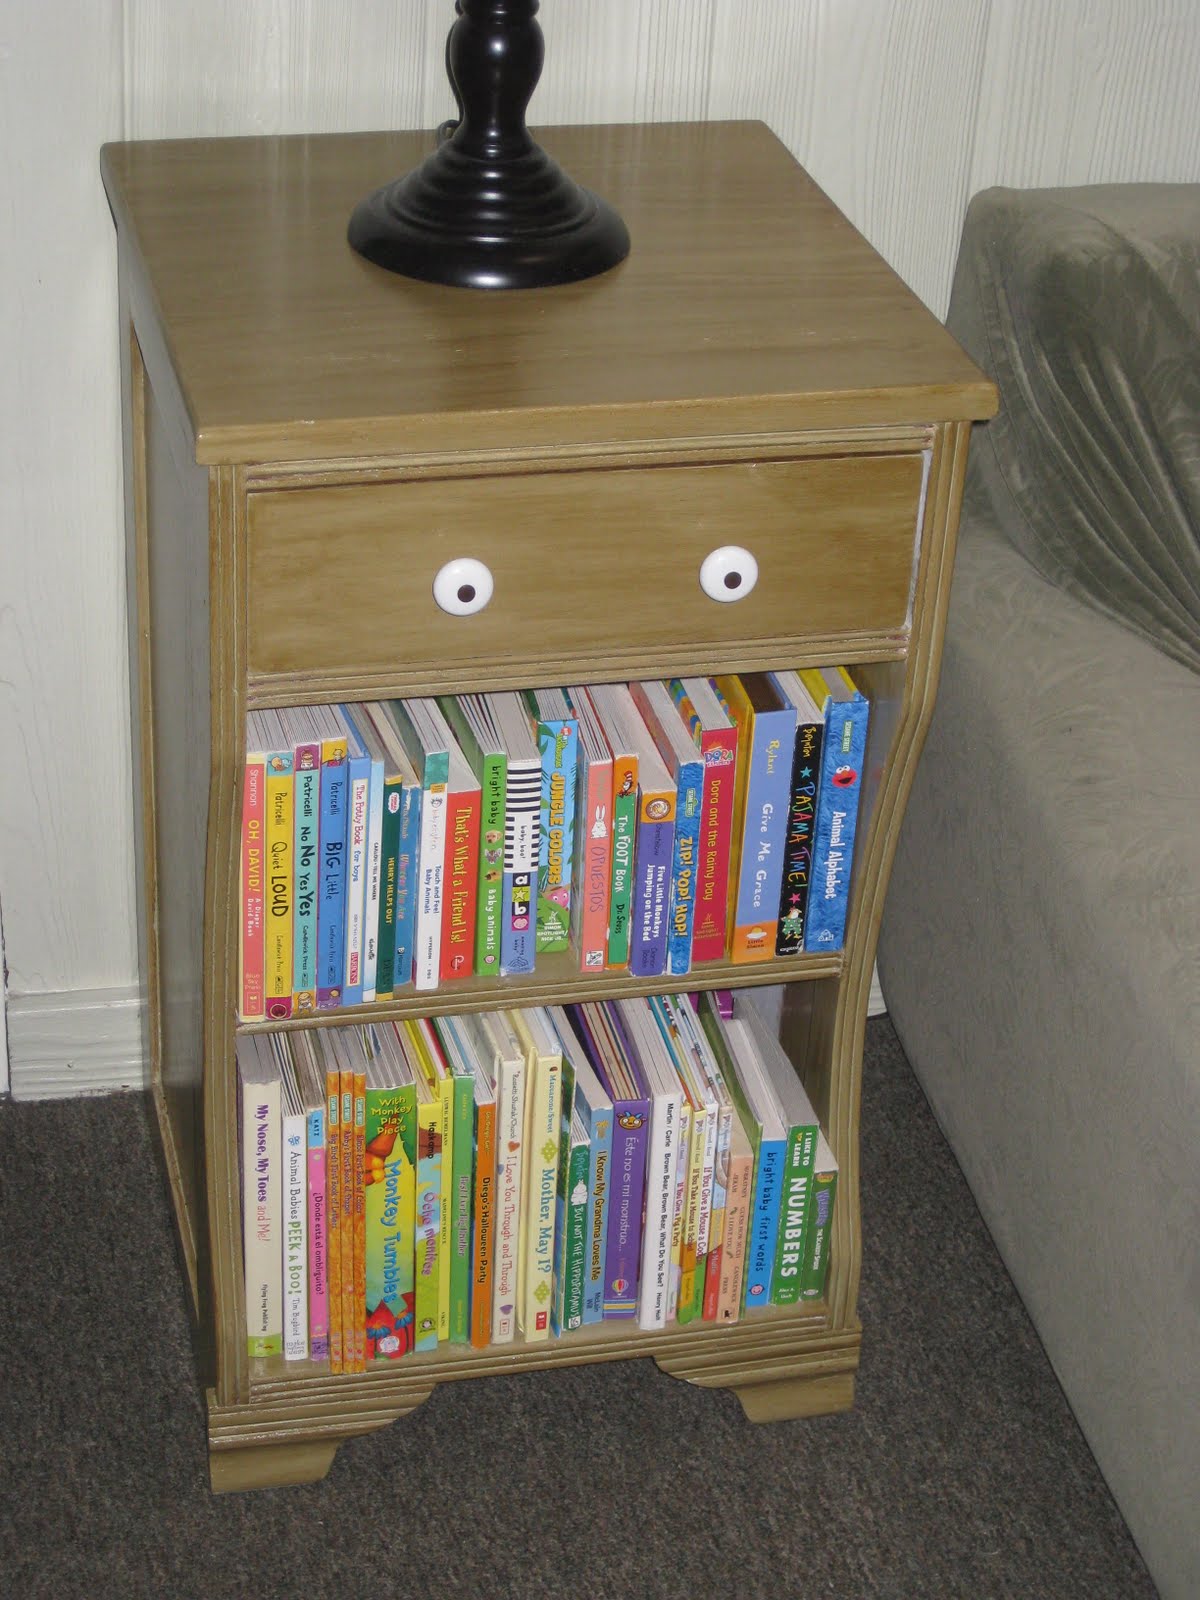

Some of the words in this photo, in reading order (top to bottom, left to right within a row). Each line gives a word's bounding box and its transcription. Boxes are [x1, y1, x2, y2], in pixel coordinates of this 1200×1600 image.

[843, 721, 852, 737] SESAME
[801, 727, 816, 757] Boynton
[842, 738, 851, 753] STREET
[250, 769, 258, 806] Shannon
[356, 785, 364, 800] The
[490, 766, 501, 798] bright
[710, 780, 721, 804] Dora
[303, 776, 313, 817] Patricelli
[330, 782, 342, 815] Patricelli
[548, 772, 565, 826] JUNGLE
[275, 792, 287, 826] Patricelli
[353, 801, 364, 824] Potty
[489, 801, 501, 824] baby
[709, 808, 719, 826] and
[759, 803, 774, 833] Give
[789, 782, 815, 842] PAJAMA
[247, 820, 259, 843] OH,
[301, 827, 311, 842] No
[354, 826, 363, 845] Book
[455, 807, 473, 843] That's
[618, 816, 629, 833] The
[829, 811, 846, 846] Animal
[616, 836, 631, 865] FOOT
[708, 831, 718, 847] the
[271, 842, 288, 870] Quiet
[300, 846, 315, 867] No
[326, 842, 342, 868] BIG
[353, 851, 361, 863] for
[452, 845, 469, 875] What
[548, 829, 564, 885] COLORS
[679, 836, 693, 866] ZIP!
[757, 841, 771, 862] Me
[247, 849, 260, 892] DAVID!
[352, 865, 360, 882] boys
[434, 866, 442, 881] Touch
[657, 866, 666, 881] Five
[704, 851, 716, 878] Rainy
[788, 846, 811, 888] TIME!
[825, 851, 843, 899] Alphabet
[300, 873, 310, 890] Yes
[326, 874, 339, 900] Little
[424, 869, 433, 887] Baby
[589, 846, 606, 913] OPUESTOS
[643, 864, 656, 897] Jumping
[677, 869, 692, 900] POP!
[753, 870, 767, 907] Grace
[271, 876, 288, 917] LOUD
[386, 884, 394, 907] HELPS
[424, 888, 432, 915] Animals
[434, 883, 442, 898] and
[655, 883, 665, 904] Little
[702, 882, 715, 900] Day
[299, 891, 314, 916] Yes
[433, 900, 441, 914] Feel
[452, 891, 469, 925] Friend
[616, 904, 625, 914] Dr.
[645, 900, 652, 909] on
[385, 909, 393, 924] OUT
[615, 916, 625, 934] Seuss
[644, 911, 653, 923] the
[652, 905, 664, 937] Monkeys
[675, 904, 689, 937] HOP!
[451, 929, 466, 943] Is!
[486, 915, 496, 949] animals
[643, 926, 652, 941] Bed
[255, 1105, 269, 1120] My
[371, 1105, 412, 1116] Monkey
[379, 1096, 406, 1106] With
[380, 1116, 404, 1125] Play
[666, 1103, 674, 1124] Martin
[255, 1124, 270, 1156] Nose,
[330, 1134, 338, 1144] Big
[377, 1125, 406, 1135] Piece
[426, 1121, 437, 1159] Haskamp
[793, 1144, 801, 1167] LEARN
[804, 1138, 812, 1153] LIKE
[255, 1158, 269, 1174] My
[289, 1151, 301, 1186] Animal
[597, 1156, 606, 1180] Know
[624, 1158, 632, 1170] no
[764, 1153, 777, 1184] bright
[802, 1156, 810, 1166] TO
[460, 1175, 470, 1193] Best
[505, 1163, 514, 1183] Love
[623, 1173, 632, 1182] es
[662, 1174, 670, 1191] Bear,
[702, 1173, 712, 1187] You
[257, 1177, 270, 1202] Toes
[381, 1159, 402, 1226] Monkey
[480, 1177, 491, 1210] Diego's
[503, 1185, 514, 1202] You
[539, 1169, 555, 1222] Mother,
[594, 1182, 605, 1196] My
[623, 1184, 631, 1196] mi
[690, 1185, 698, 1200] Take
[700, 1188, 711, 1204] Give
[760, 1187, 774, 1211] baby
[258, 1205, 270, 1220] and
[290, 1188, 301, 1219] Babies
[422, 1192, 437, 1225] Ocho
[574, 1205, 583, 1221] BUT
[689, 1205, 697, 1223] Mouse
[501, 1206, 512, 1241] Through
[593, 1198, 604, 1237] Grandma
[660, 1214, 668, 1230] Bear,
[698, 1211, 708, 1234] Mouse
[760, 1217, 773, 1240] first
[781, 1178, 807, 1277] NUMBERS
[258, 1224, 271, 1242] Me!
[288, 1221, 302, 1250] PEEK
[458, 1227, 468, 1256] Brother
[479, 1211, 490, 1257] Halloween
[536, 1228, 552, 1255] May
[573, 1224, 582, 1239] NOT
[659, 1231, 667, 1248] What
[315, 1241, 322, 1249] el
[503, 1244, 511, 1258] and
[573, 1241, 582, 1255] THE
[592, 1239, 602, 1264] Loves
[659, 1249, 666, 1258] Do
[383, 1231, 402, 1303] Tumbles
[538, 1260, 551, 1273] I?
[755, 1244, 767, 1271] words
[313, 1251, 323, 1295] ombliguito?
[478, 1260, 488, 1283] Party
[500, 1260, 510, 1296] Through
[592, 1266, 600, 1280] Me
[571, 1258, 582, 1316] HIPPOPOTAMUS
[292, 1297, 300, 1310] Tim
[291, 1312, 301, 1336] Bugbird
